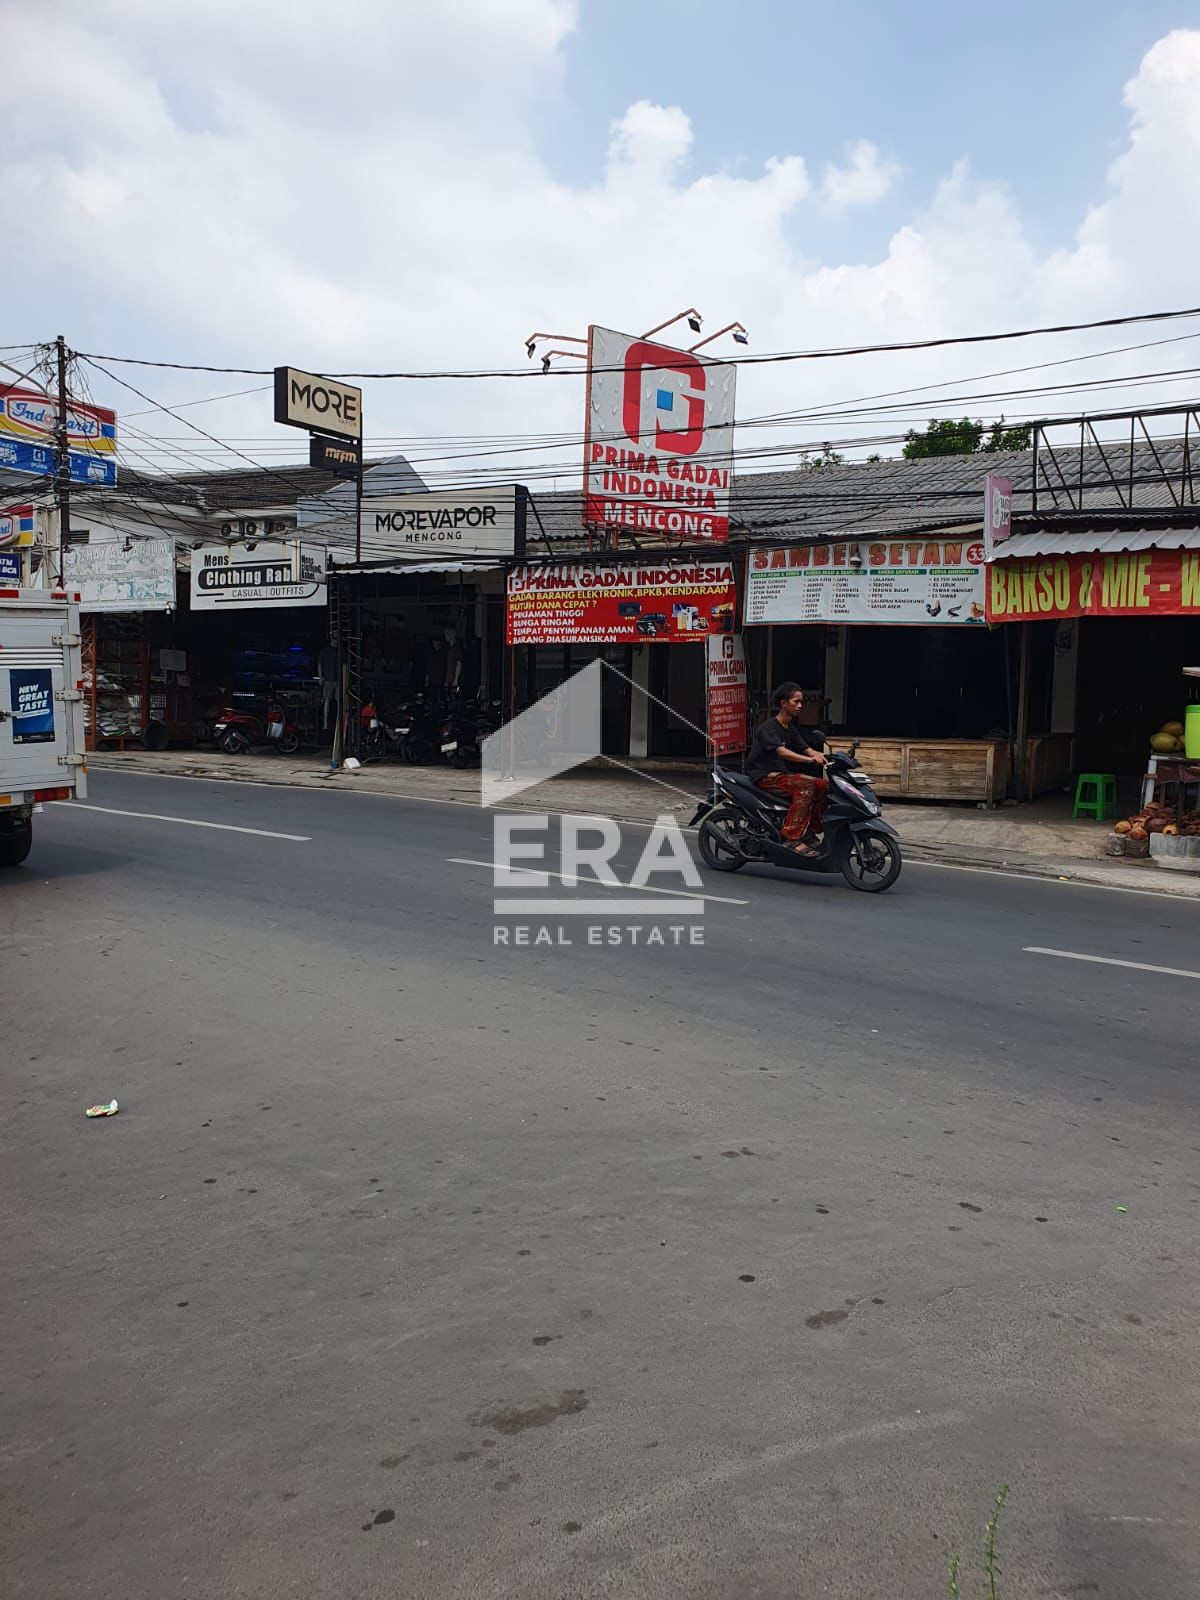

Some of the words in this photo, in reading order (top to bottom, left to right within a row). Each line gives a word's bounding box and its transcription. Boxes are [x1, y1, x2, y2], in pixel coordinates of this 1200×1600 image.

[292, 379, 356, 421] MORE
[12, 402, 95, 434] Indoaret
[592, 443, 660, 475] PRIMA
[666, 459, 728, 489] GADAI
[603, 471, 717, 510] INDONESIA
[375, 505, 496, 532] MOREVAPOR
[604, 502, 713, 537] MENCONG
[406, 531, 462, 542] MENCONG
[204, 554, 229, 567] Mens
[869, 543, 962, 567] SETAN
[206, 569, 261, 586] Clothing
[266, 567, 291, 583] Rab
[580, 569, 632, 589] GADAI
[637, 566, 734, 586] INDONESIA
[992, 559, 1071, 615] BAKSO
[1079, 563, 1094, 608] &
[1102, 555, 1152, 608] MIE
[231, 588, 262, 598] CASUAL
[269, 586, 304, 596] OUTFITS
[509, 592, 535, 602] GADAI
[536, 591, 576, 600] BARANG
[509, 602, 535, 611] BUTUH
[536, 601, 561, 610] DANA
[563, 600, 590, 609] CEPAT
[513, 610, 553, 619] PINJAMAN
[555, 609, 584, 617] TINGGI
[513, 619, 540, 627] BUNGA
[541, 618, 575, 626] RINGAN
[513, 628, 542, 636] TEMPAT
[543, 626, 605, 635] PENYIMPANAN
[607, 625, 634, 634] AMAN
[513, 636, 545, 645] BARANG
[546, 635, 617, 643] DIASURANSIKAN
[19, 684, 39, 695] NEW
[19, 690, 49, 703] GREAT
[20, 700, 48, 712] TASTE
